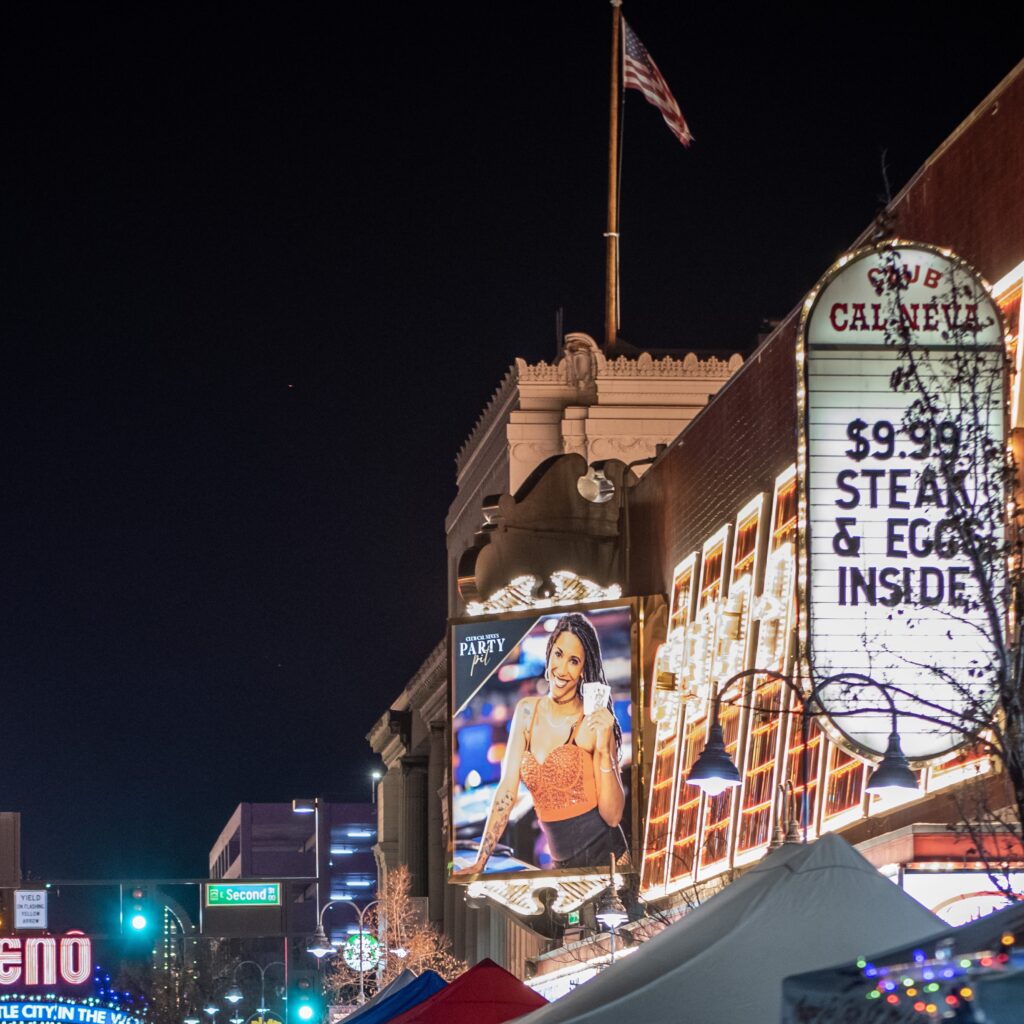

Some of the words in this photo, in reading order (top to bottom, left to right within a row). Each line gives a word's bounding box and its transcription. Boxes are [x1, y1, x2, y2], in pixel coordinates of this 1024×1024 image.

[829, 303, 887, 332] CAL
[899, 303, 982, 332] NEVA
[845, 418, 962, 462] $9.99
[834, 467, 974, 511] STEAK
[832, 517, 861, 558] &
[838, 566, 970, 607] INSIDE
[459, 638, 506, 656] PARTY
[20, 894, 41, 902] YIELD
[226, 888, 267, 901] Second
[21, 1004, 54, 1019] CITY
[57, 1006, 75, 1021] IN
[77, 1007, 107, 1024] THE
